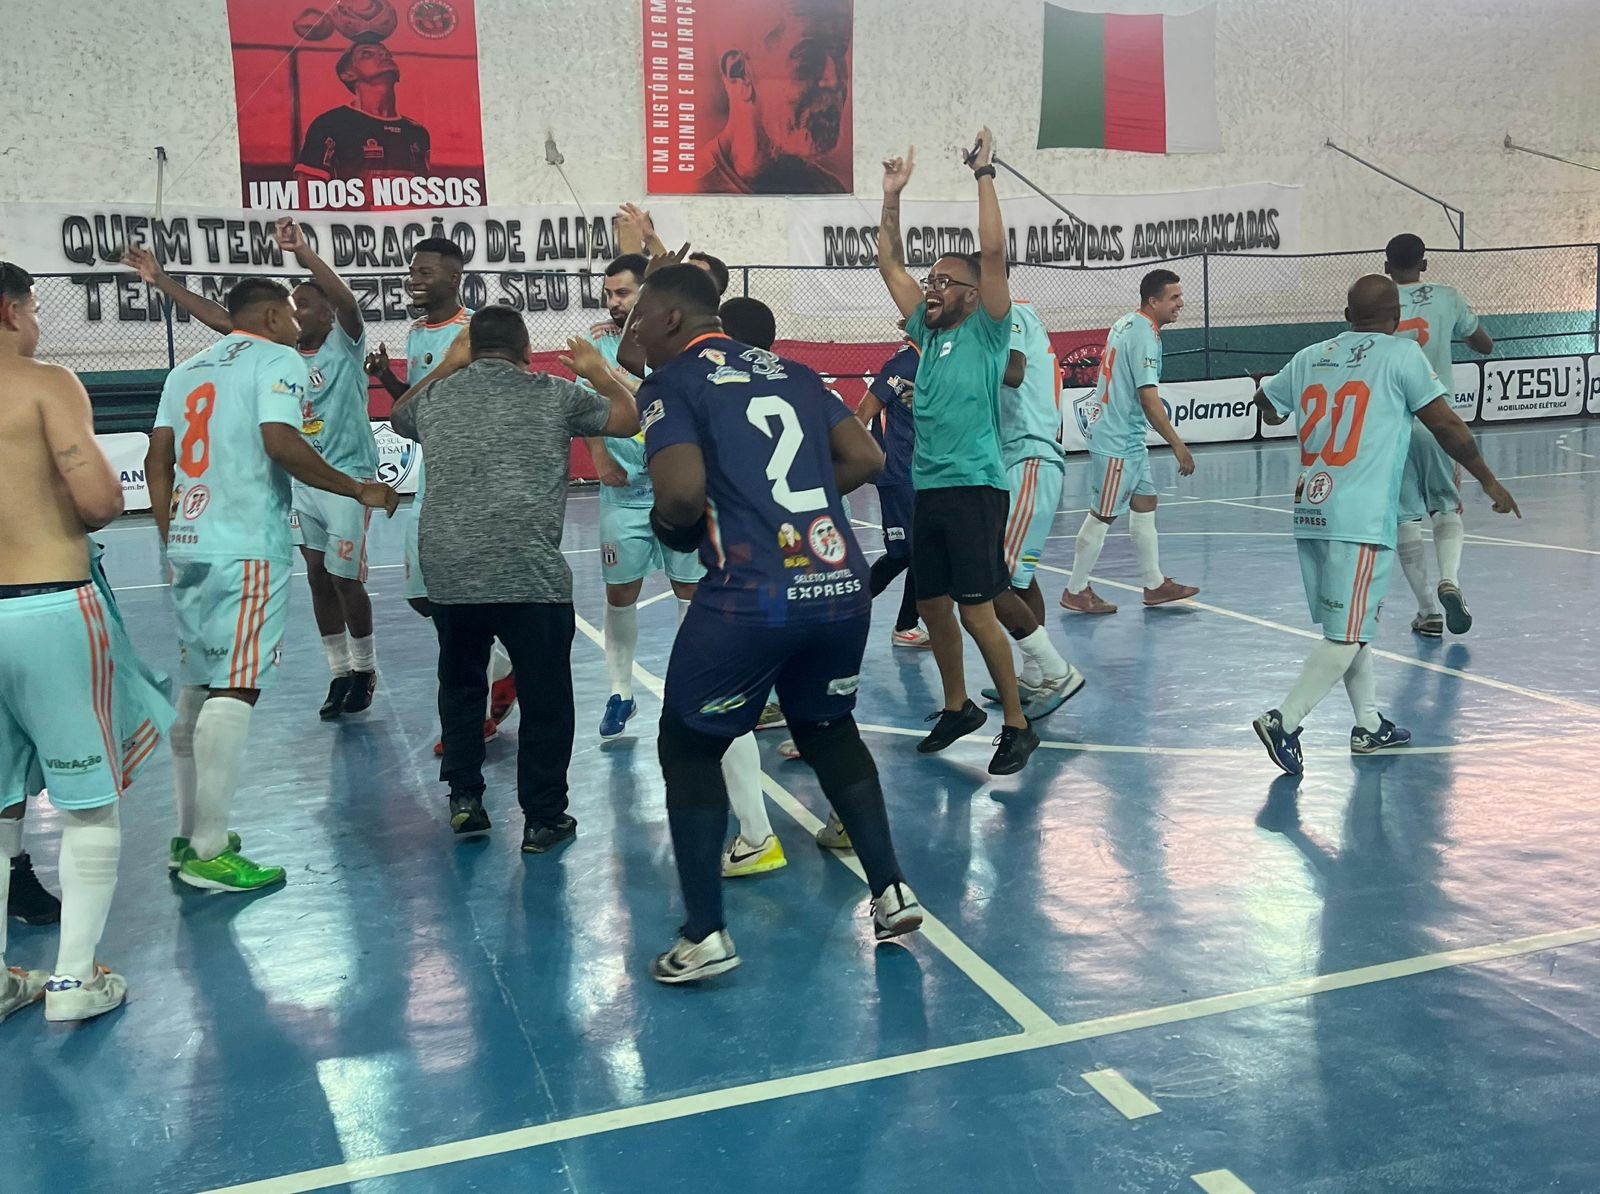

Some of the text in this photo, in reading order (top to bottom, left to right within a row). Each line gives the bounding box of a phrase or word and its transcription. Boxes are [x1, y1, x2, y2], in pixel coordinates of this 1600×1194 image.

[651, 31, 668, 49] DE
[648, 56, 669, 128] HISTÓRIA
[675, 0, 696, 172] CARINHO E ADMIRAÇ
[652, 136, 669, 173] UMA
[249, 176, 481, 210] UM DOS NOSSOS
[62, 214, 192, 266] QUEM
[197, 218, 284, 267] TEM
[485, 219, 526, 263] DE
[823, 226, 881, 267] NOSS
[906, 226, 975, 264] GRITO
[1025, 218, 1083, 264] ALÉM
[1086, 224, 1125, 261] DAS
[1130, 208, 1280, 259] ARQUIBANCADAS
[498, 268, 569, 313] SEU
[1496, 366, 1571, 400] YESU
[1174, 398, 1255, 427] plamer
[1300, 380, 1370, 467] 20
[1497, 400, 1568, 412] MOBILIDADE ELÉTRICA
[178, 382, 217, 479] 8
[746, 395, 829, 514] 2
[168, 534, 199, 545] PRESS
[1293, 515, 1327, 527] XPRESS
[786, 579, 862, 600] EXPRESS
